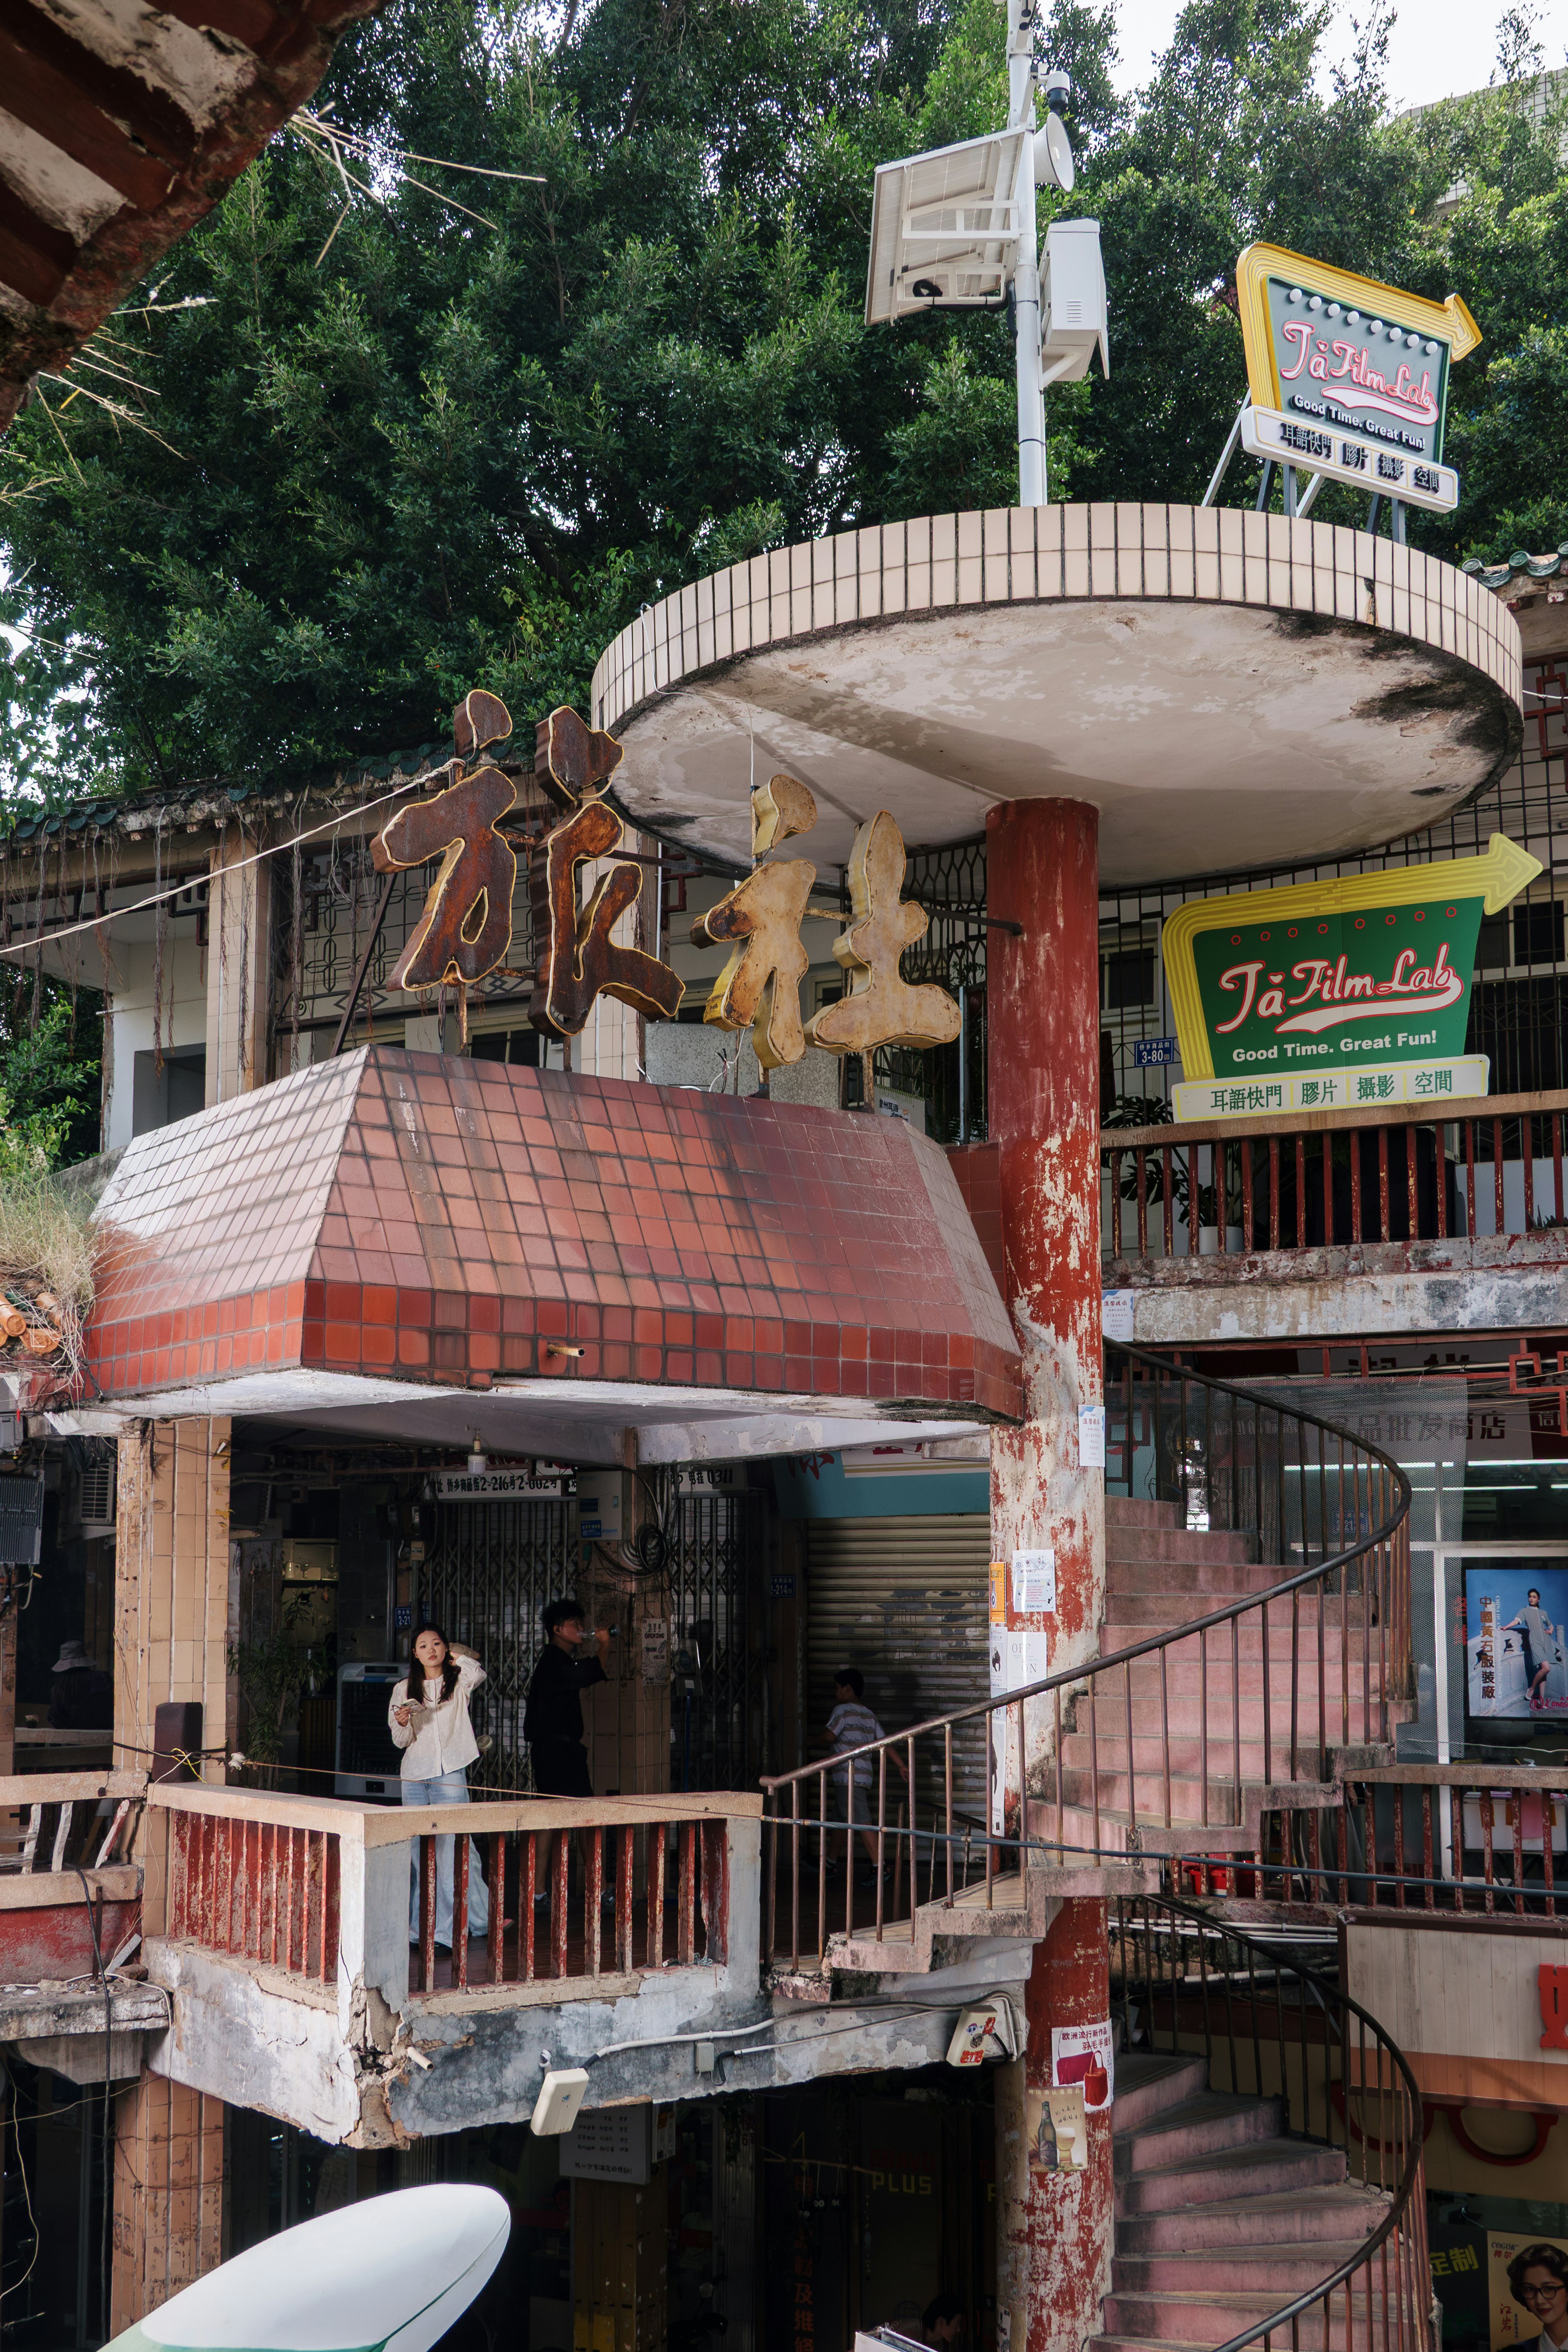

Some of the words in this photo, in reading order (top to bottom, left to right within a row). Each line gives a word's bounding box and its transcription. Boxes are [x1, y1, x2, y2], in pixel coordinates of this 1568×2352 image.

[1330, 340, 1387, 393] Film
[1387, 364, 1432, 406] Lab
[1294, 394, 1325, 417] Good
[1330, 407, 1363, 427] Time.
[1366, 419, 1398, 440] Great
[1401, 431, 1426, 450] Fun!
[1283, 423, 1332, 458] 耳語快門
[1344, 442, 1369, 470] 膠片
[1381, 453, 1405, 478] 攝影
[1417, 466, 1440, 492] 空間
[1288, 954, 1374, 1005] Film
[1375, 942, 1454, 996] Lab
[1142, 1050, 1163, 1063] 3-80
[1232, 1044, 1278, 1062] Good
[1283, 1040, 1333, 1058] Time.
[1340, 1034, 1392, 1052] Great
[1397, 1029, 1436, 1048] Fun!
[1210, 1085, 1282, 1111] 耳語快門
[1301, 1080, 1337, 1105] 膠片
[1357, 1074, 1395, 1101] 攝影
[1415, 1070, 1453, 1095] 空間
[707, 1468, 733, 1484] 0311
[399, 1615, 411, 1625] 2-21
[1062, 2026, 1107, 2041] 欧洲流行新作品
[872, 2172, 932, 2195] PLUS
